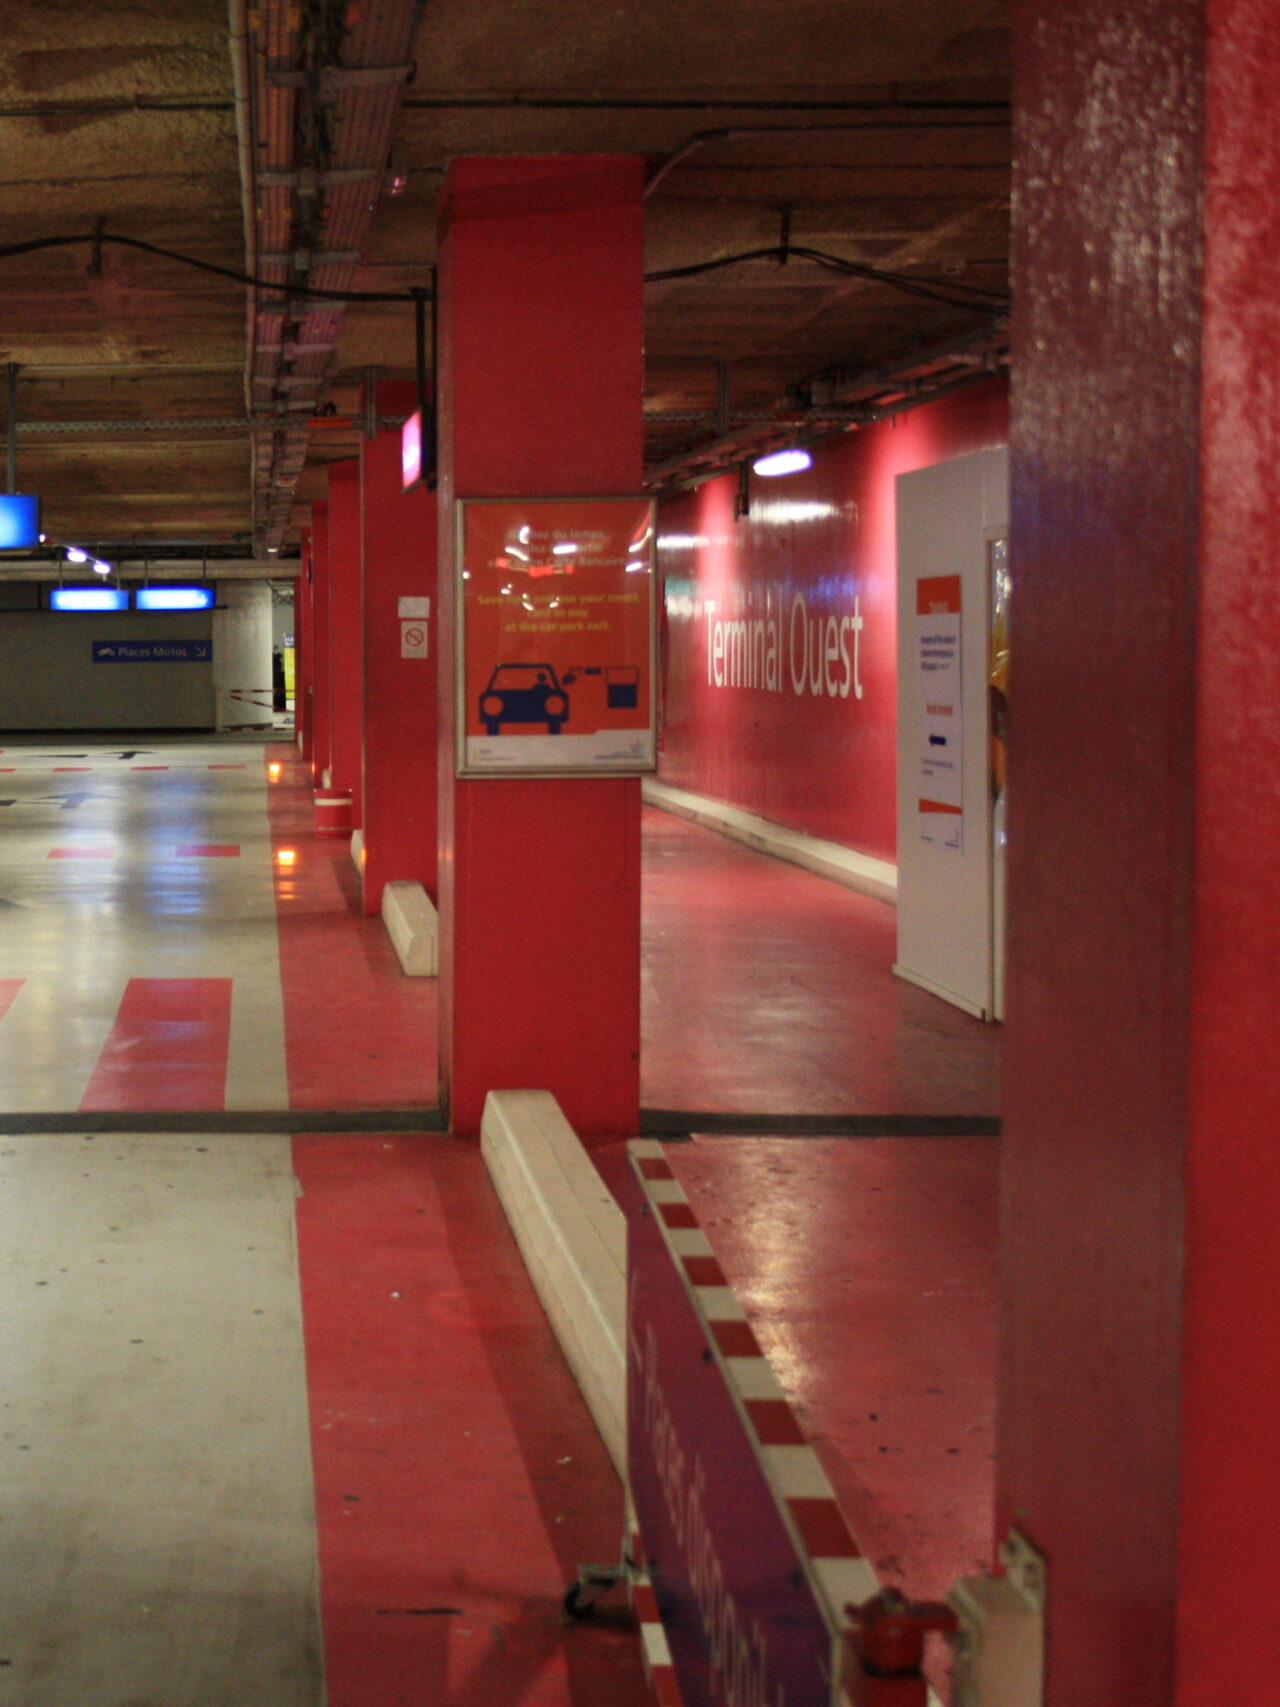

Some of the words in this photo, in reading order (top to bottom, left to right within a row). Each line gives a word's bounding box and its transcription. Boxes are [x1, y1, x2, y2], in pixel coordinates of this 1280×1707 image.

[118, 646, 151, 657] Places
[153, 646, 187, 657] Motos
[704, 586, 783, 692] Terminal
[790, 591, 863, 700] Ouest
